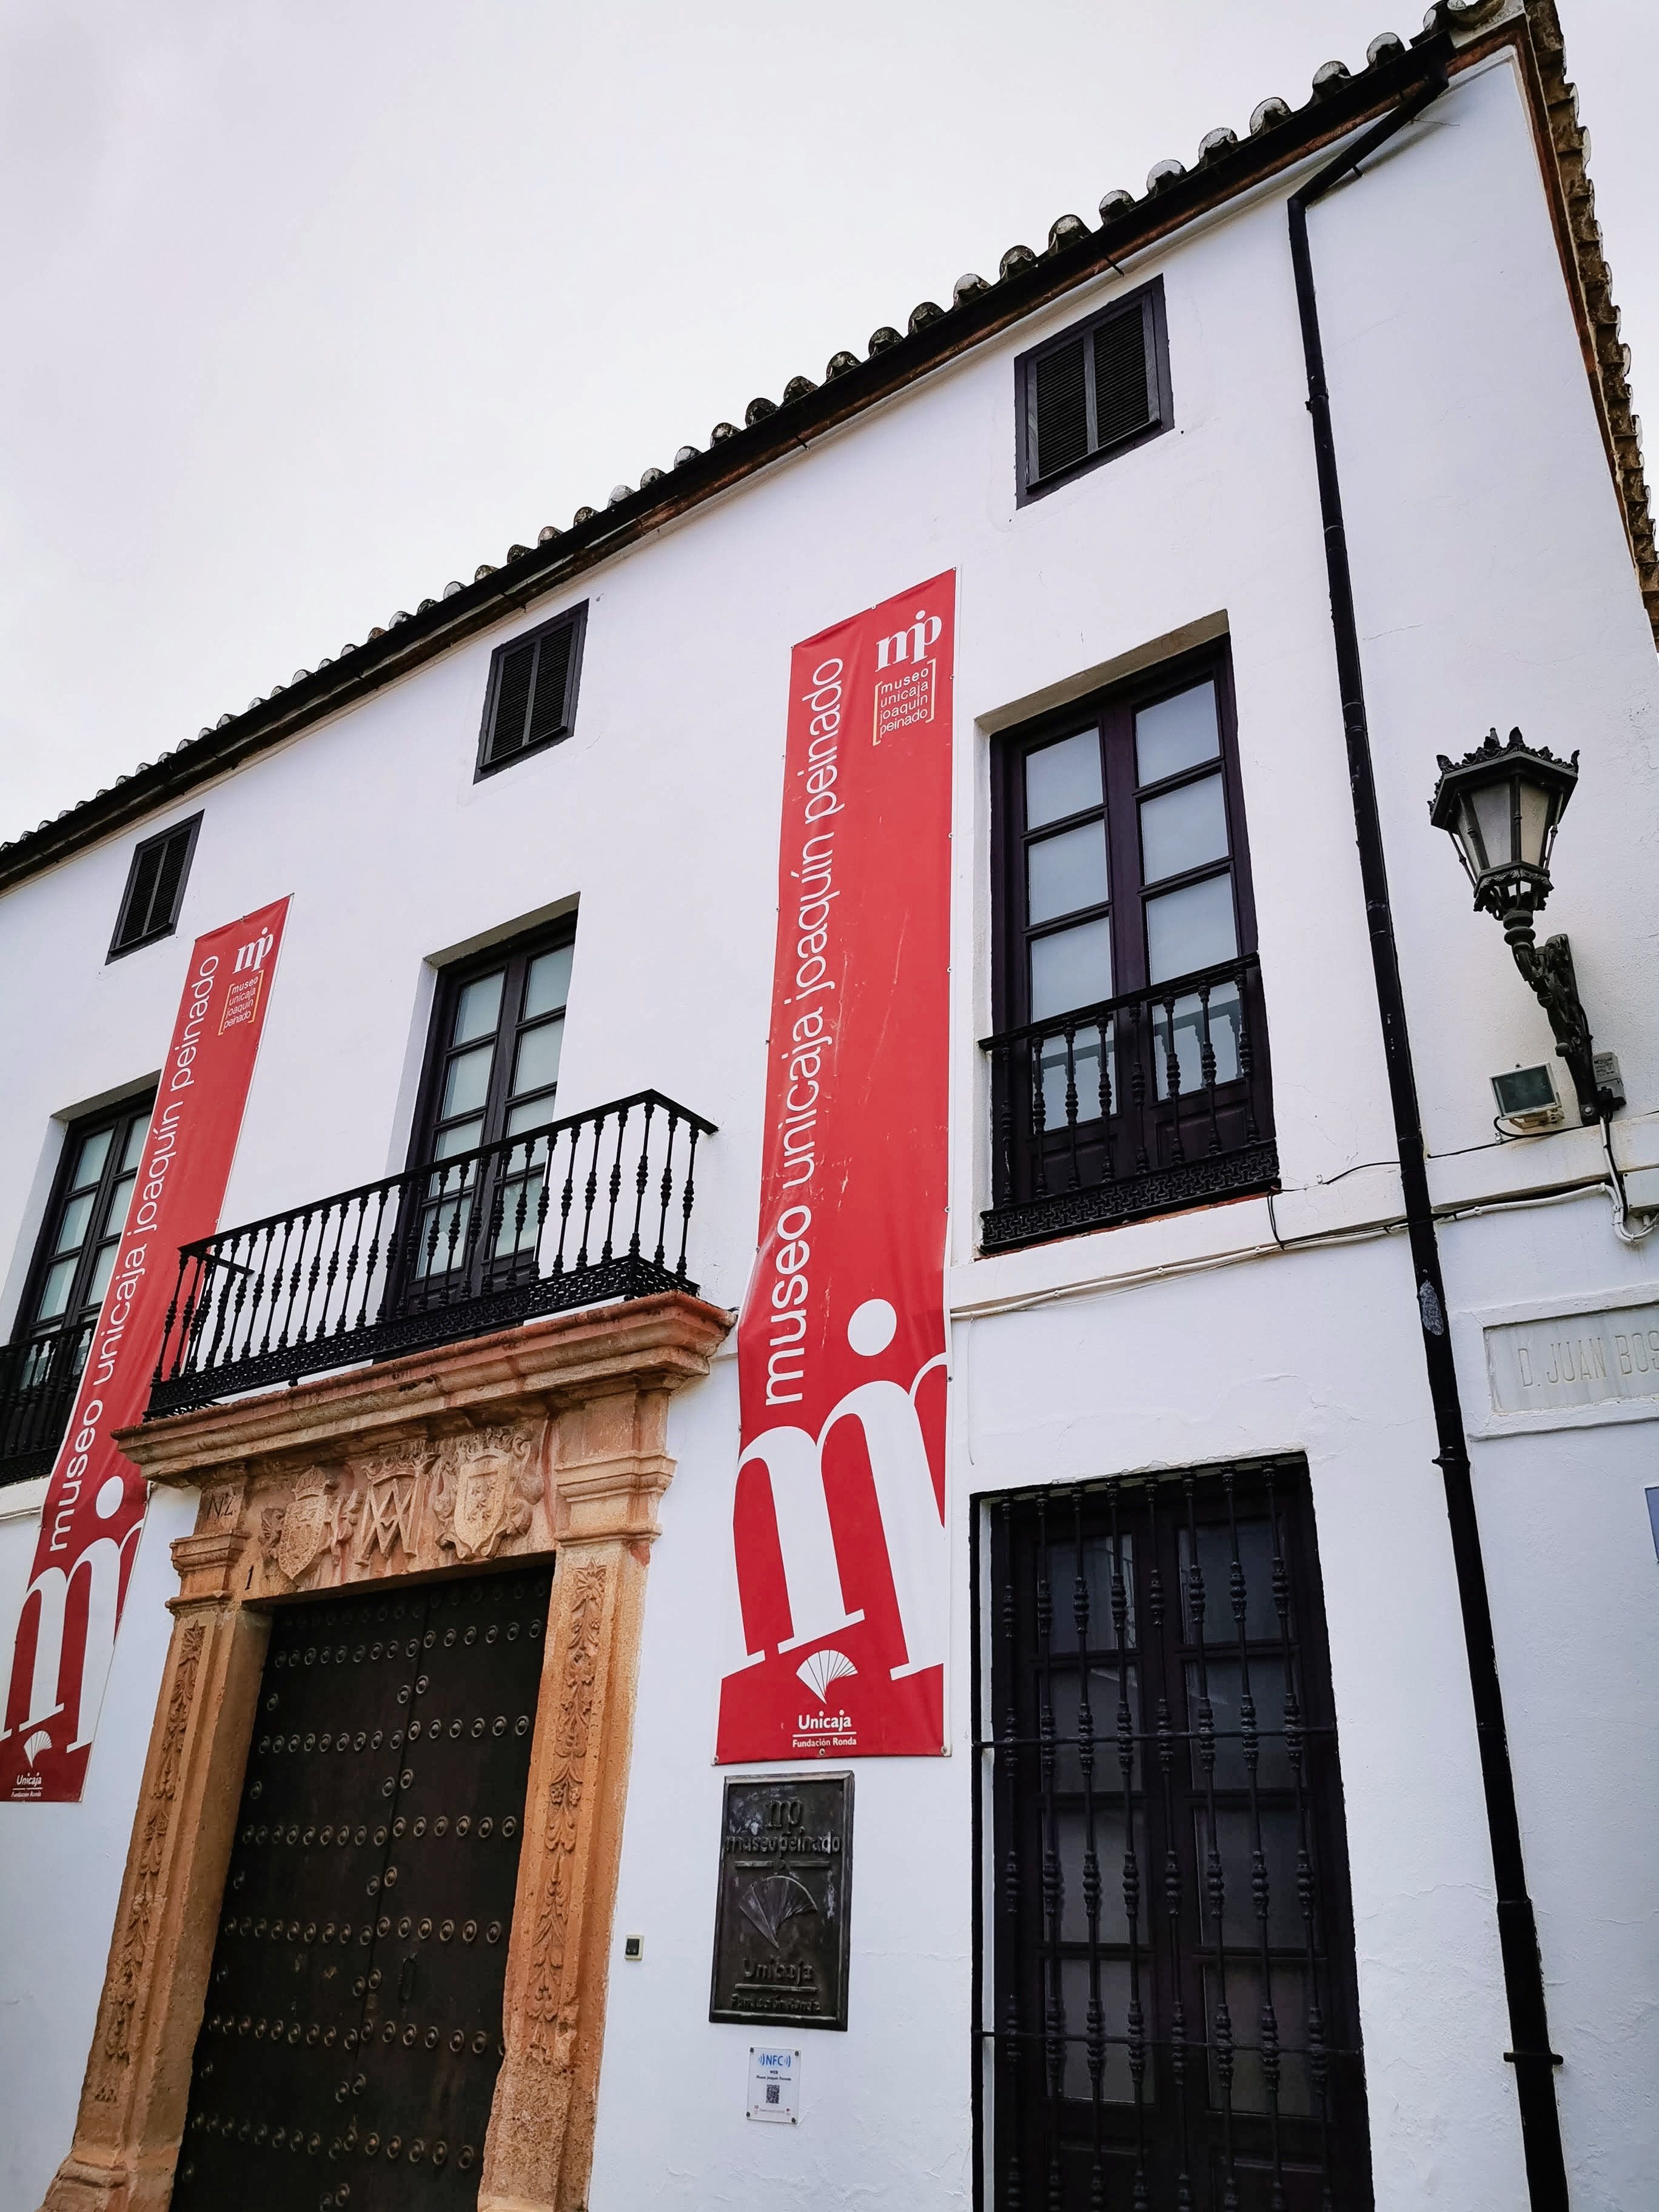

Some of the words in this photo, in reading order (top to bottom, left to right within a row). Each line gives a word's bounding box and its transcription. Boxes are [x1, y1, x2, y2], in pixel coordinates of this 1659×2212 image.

[880, 668, 930, 694] museo
[880, 681, 929, 708] unicaja
[879, 694, 928, 725] joaquín
[879, 708, 928, 739] peinado
[797, 657, 845, 825] peinado
[784, 831, 840, 1005] joaquín
[229, 987, 256, 1006] unicaja
[232, 976, 258, 995] museo
[223, 1010, 252, 1031] peinado
[778, 1006, 833, 1189] unicaja
[50, 1398, 104, 1552] museo
[93, 1243, 147, 1386] unicaja
[127, 1101, 184, 1237] joaquín
[170, 955, 219, 1092] peinado
[766, 1205, 812, 1406] museo
[1517, 1347, 1541, 1387] D.
[1546, 1338, 1607, 1384] JUAN
[798, 1709, 852, 1732] Unicaja
[792, 1738, 831, 1748] Fundación
[833, 1737, 857, 1746] Ronda
[16, 1772, 42, 1787] Unicaja
[766, 2054, 783, 2066] NFC
